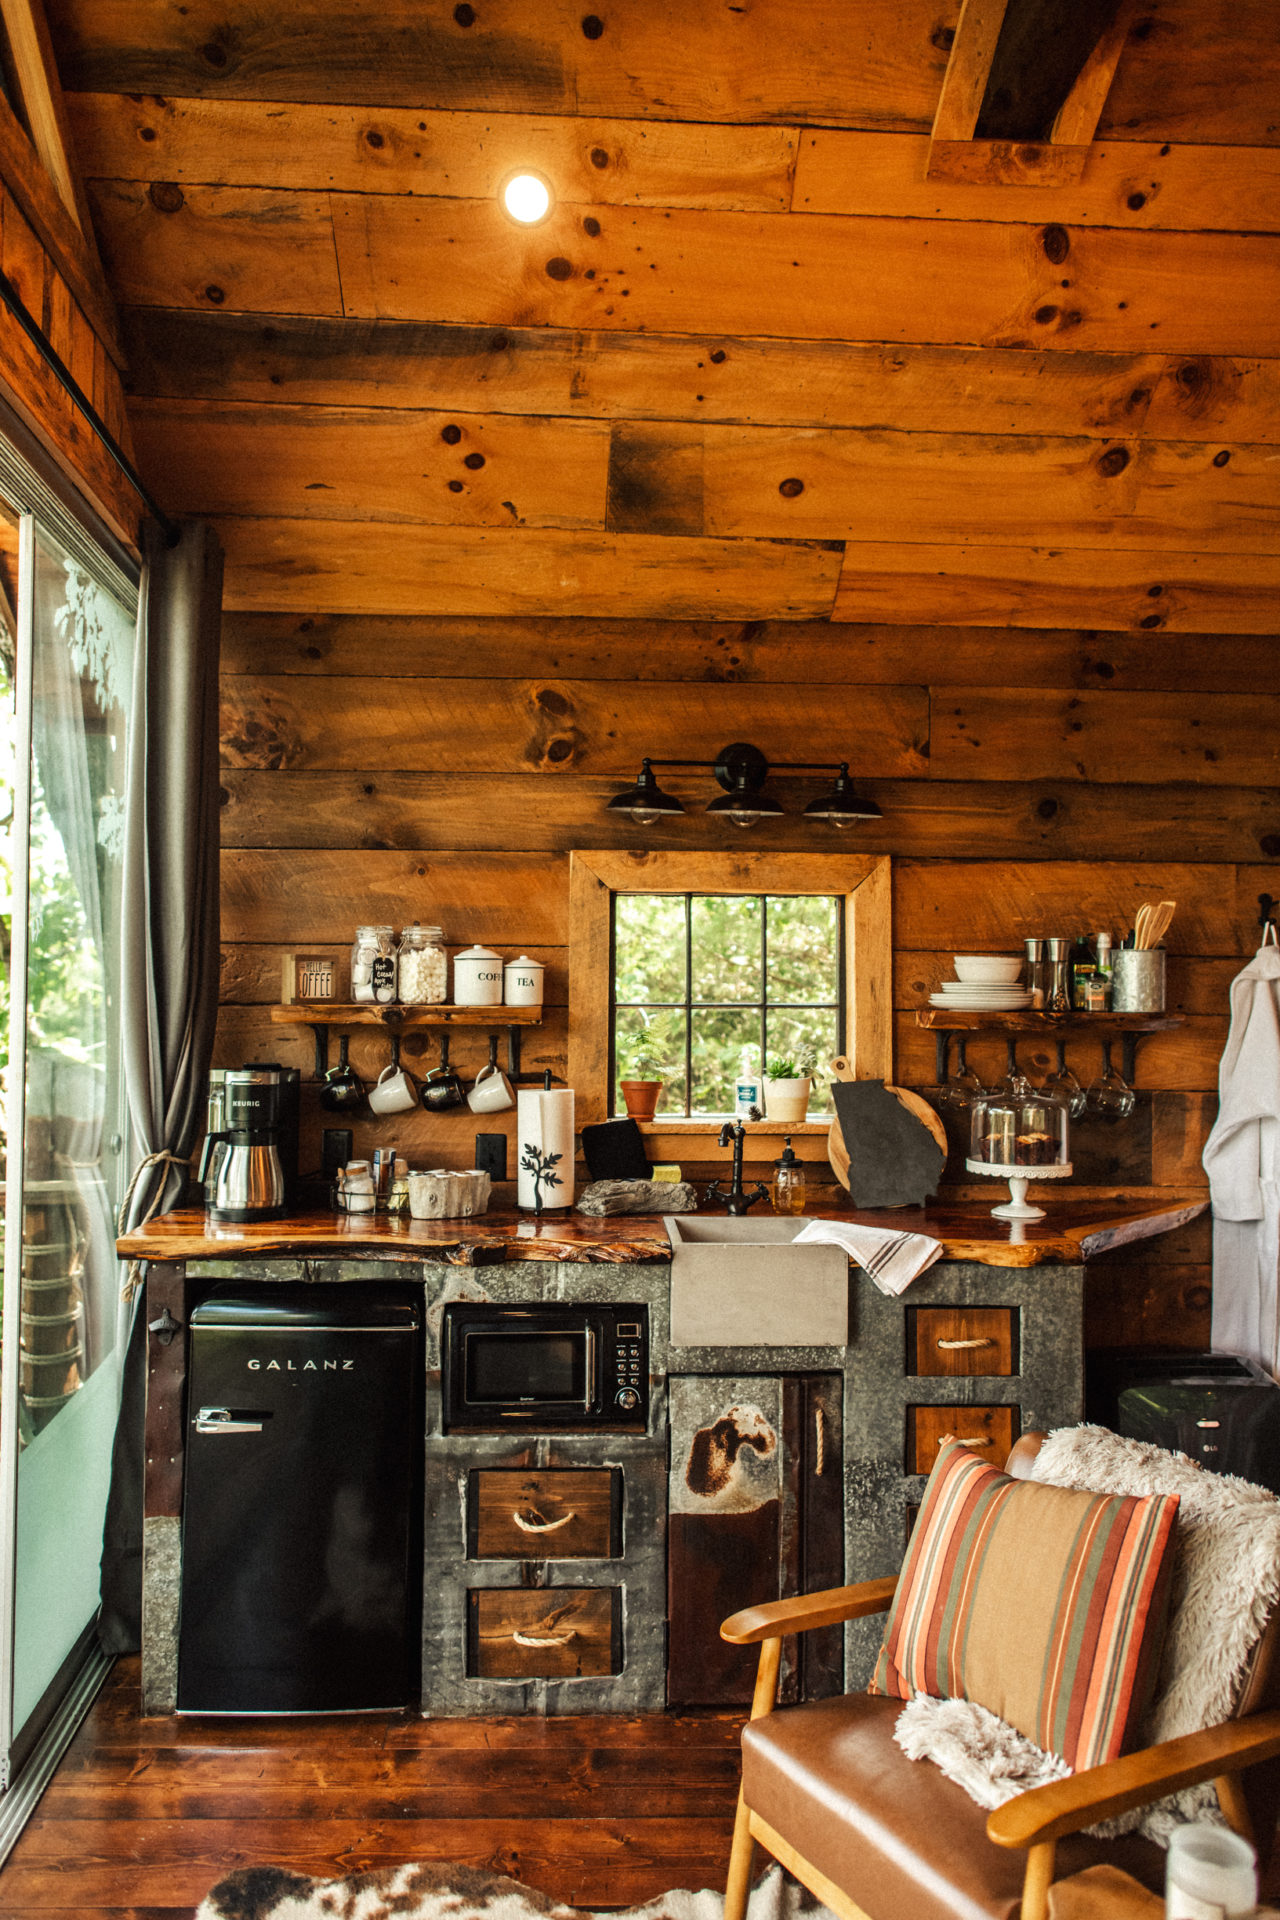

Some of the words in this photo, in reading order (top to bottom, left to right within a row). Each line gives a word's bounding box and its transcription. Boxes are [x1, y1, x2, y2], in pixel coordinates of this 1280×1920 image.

[300, 972, 332, 997] OFFEE
[517, 978, 535, 986] TEA
[247, 1359, 354, 1371] GALANZ
